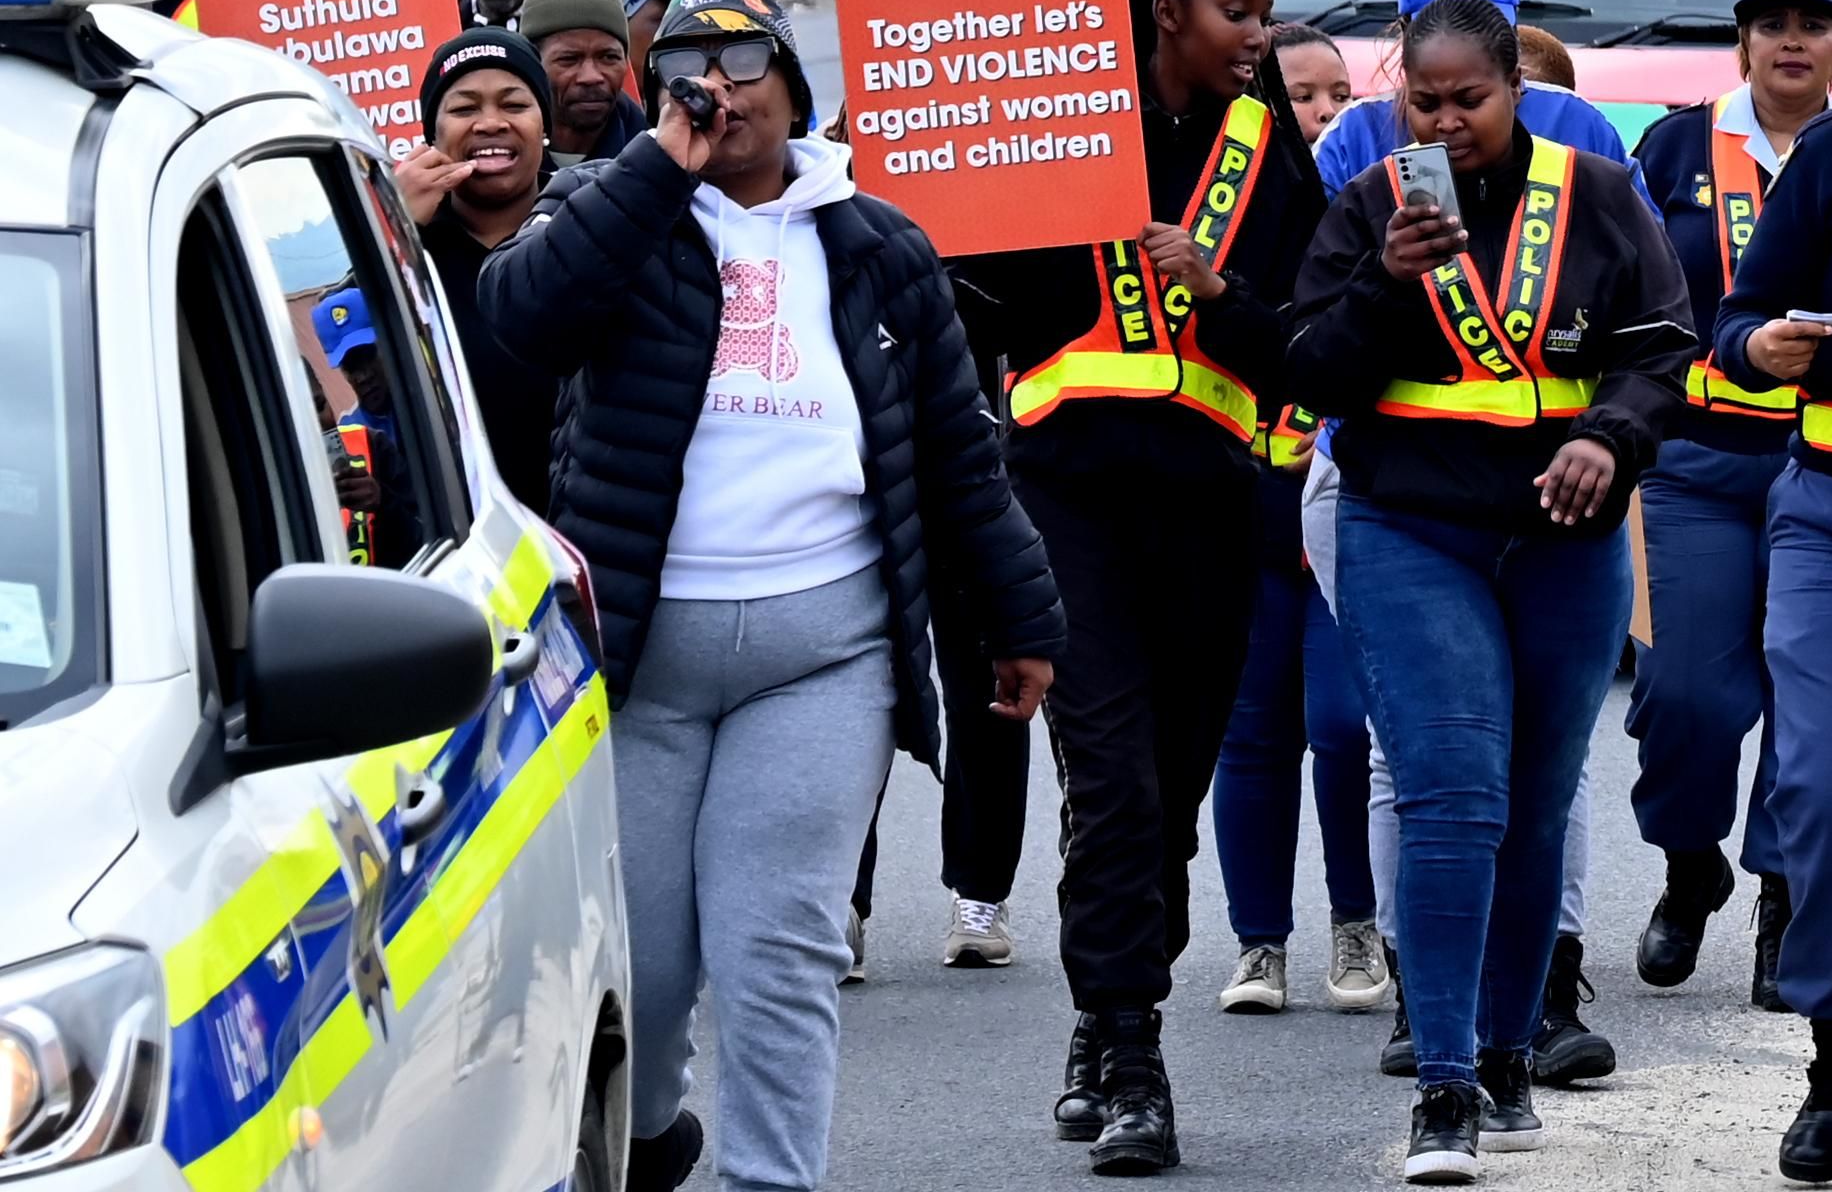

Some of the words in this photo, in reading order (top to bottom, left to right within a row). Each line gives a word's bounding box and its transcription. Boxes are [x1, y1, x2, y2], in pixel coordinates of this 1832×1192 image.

[275, 25, 425, 65] bulawa
[458, 44, 507, 63] EXCUSE
[866, 10, 1024, 54] Together
[1034, 0, 1104, 34] let's
[862, 58, 934, 92] END
[940, 40, 1118, 85] VIOLENCE
[856, 95, 992, 141] against
[1001, 88, 1133, 122] women
[884, 141, 956, 176] and
[965, 132, 1112, 168] children
[1164, 149, 1248, 333] POLC
[1503, 189, 1555, 343] POLIC
[1113, 240, 1150, 344] ICE
[1434, 266, 1513, 375] LICE
[752, 396, 823, 420] BEAR
